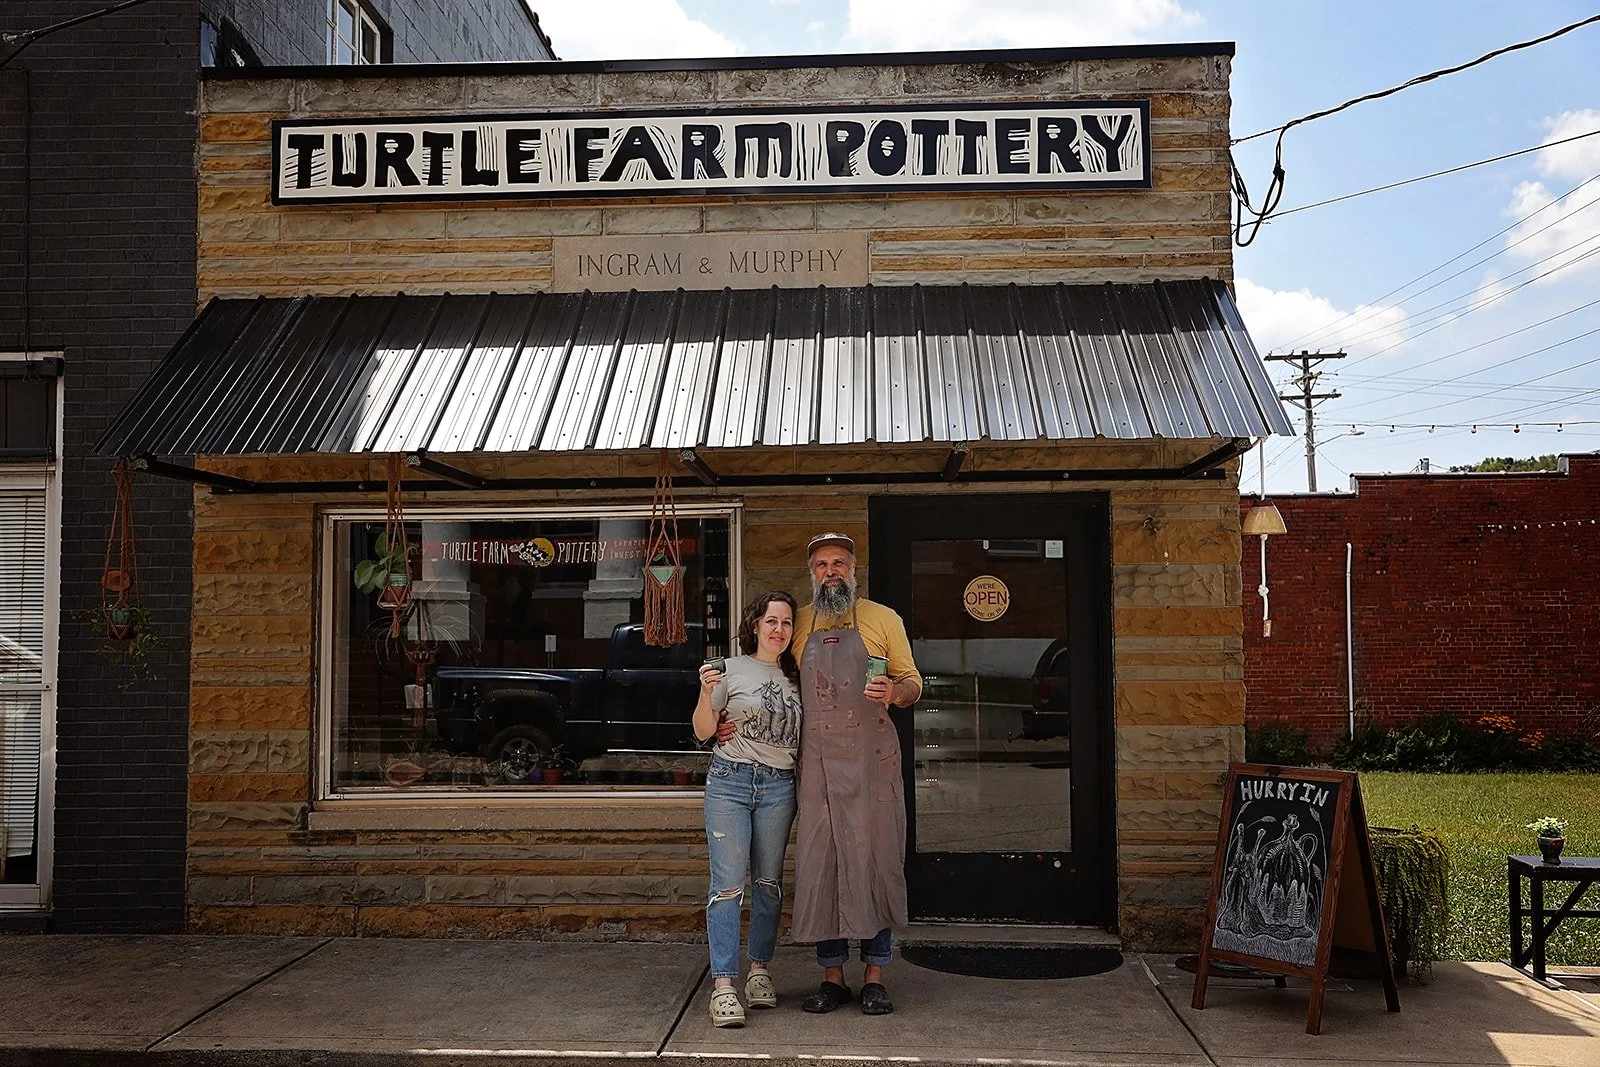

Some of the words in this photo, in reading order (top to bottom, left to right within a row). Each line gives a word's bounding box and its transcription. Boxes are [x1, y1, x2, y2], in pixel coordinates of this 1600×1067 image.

[286, 128, 542, 190] TURTLE
[574, 121, 792, 183] FARM
[826, 114, 1134, 178] POTTERY
[577, 252, 682, 277] INGRAM
[698, 256, 713, 275] &
[728, 248, 844, 274] MURPHY
[441, 541, 478, 562] TURTLE
[481, 541, 510, 565] FARM
[557, 541, 607, 564] POTTERY
[966, 591, 1007, 604] OPEN
[1240, 780, 1299, 801] HURRY
[1299, 782, 1330, 807] IN
